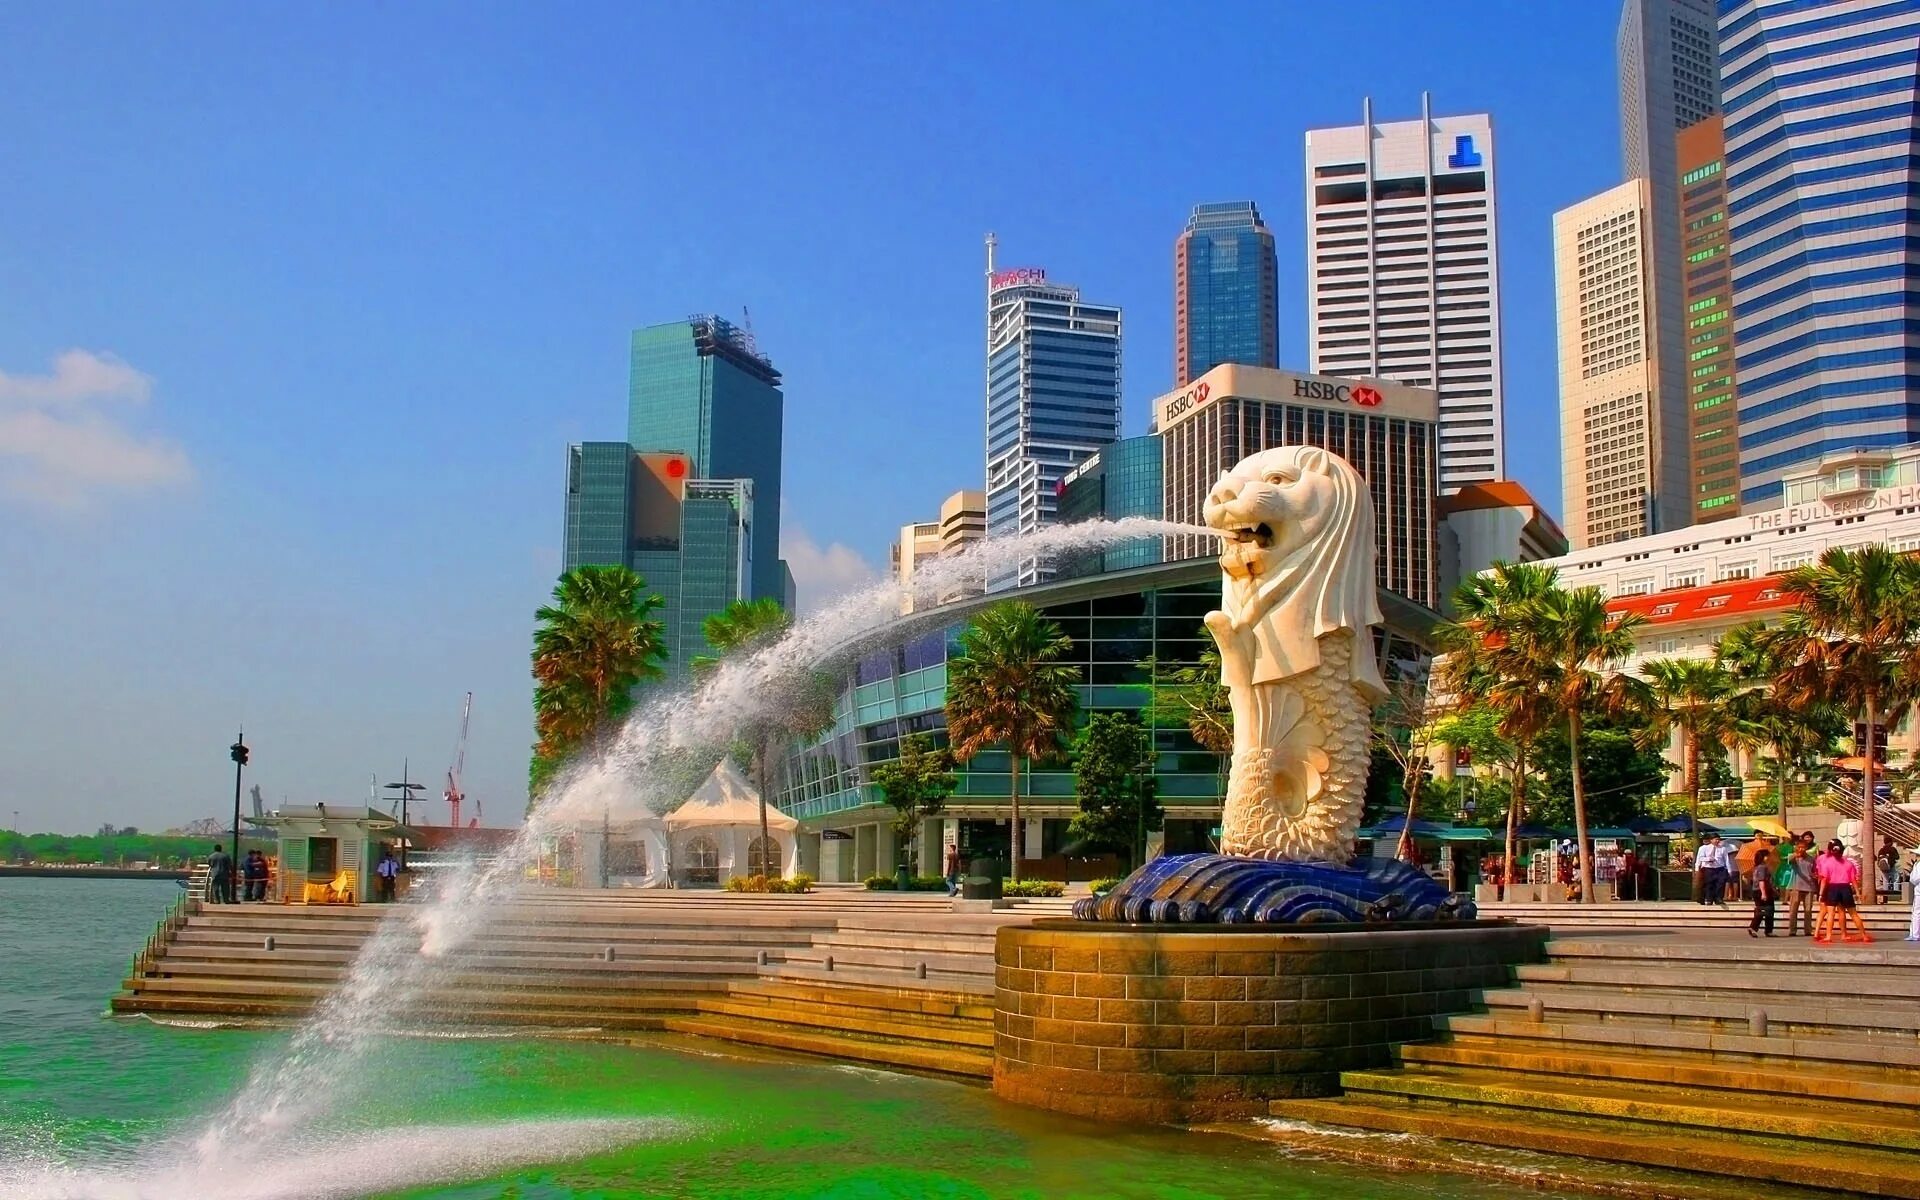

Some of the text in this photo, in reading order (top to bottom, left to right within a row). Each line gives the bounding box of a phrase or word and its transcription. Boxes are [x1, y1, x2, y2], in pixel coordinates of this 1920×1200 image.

[1166, 390, 1194, 422] HSBC
[1293, 379, 1349, 402] HSBC
[1749, 486, 1920, 530] THE FULLERTON H
